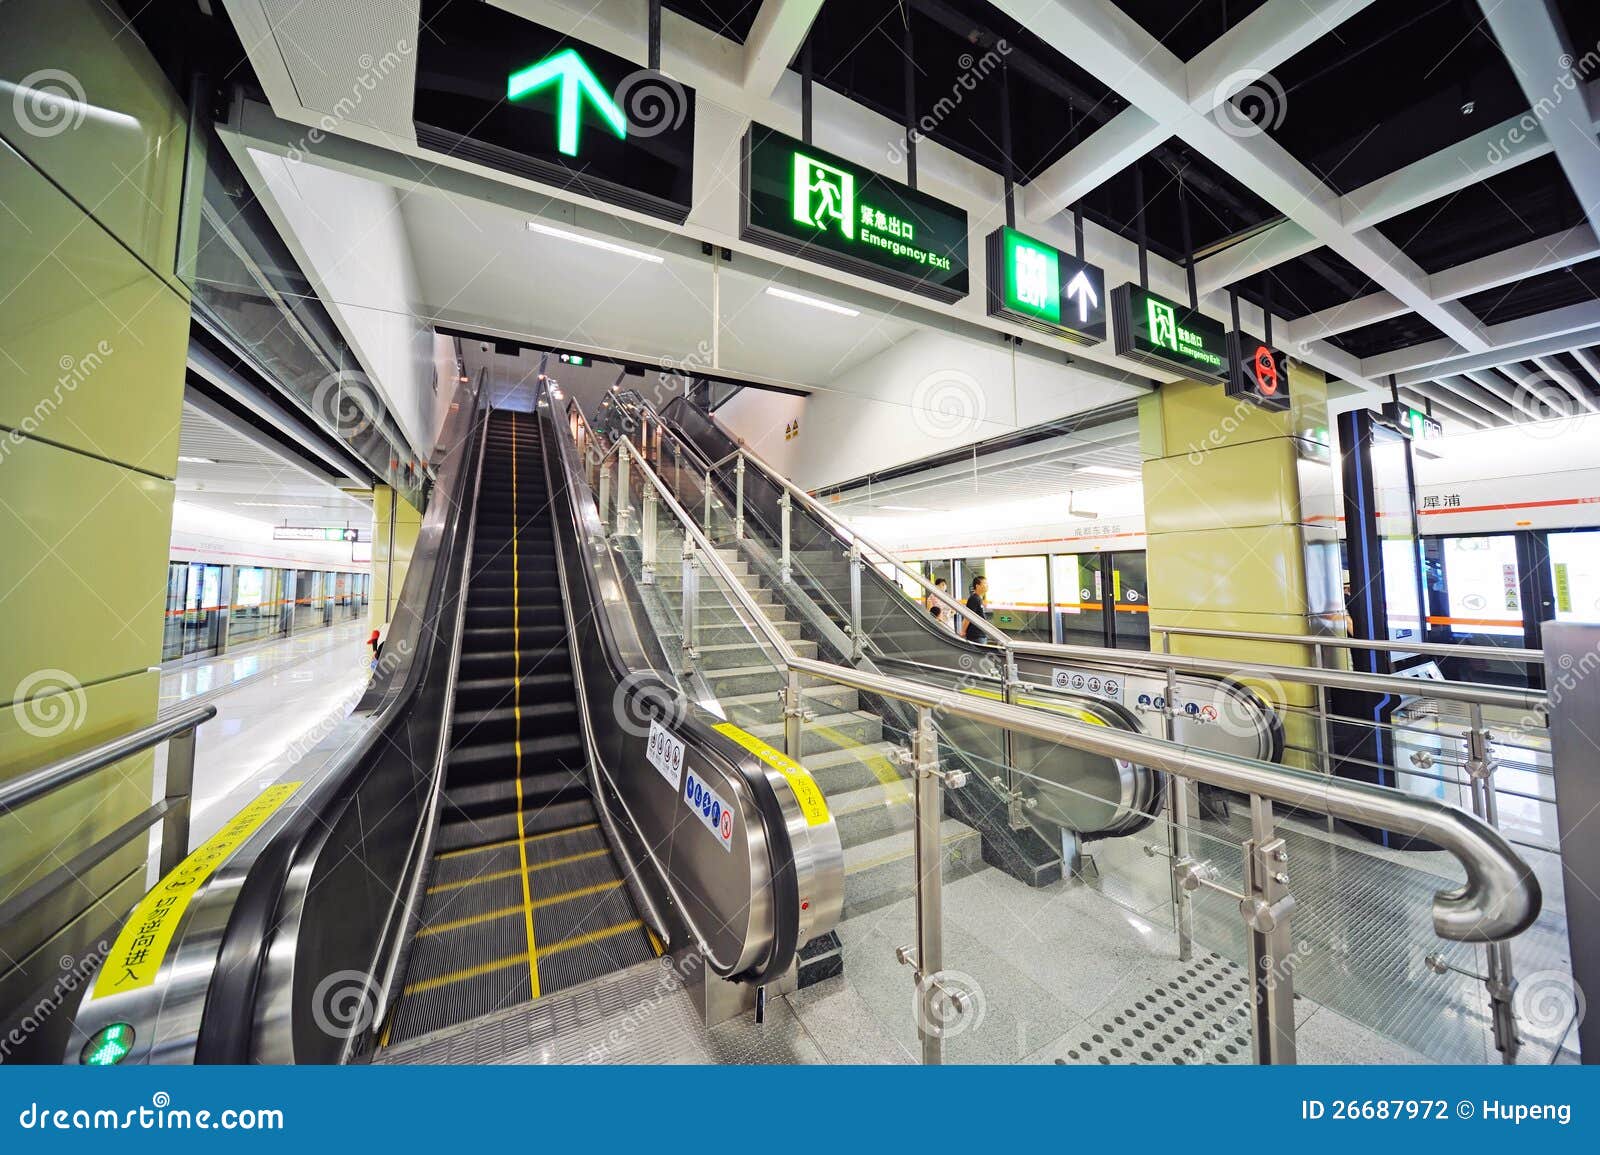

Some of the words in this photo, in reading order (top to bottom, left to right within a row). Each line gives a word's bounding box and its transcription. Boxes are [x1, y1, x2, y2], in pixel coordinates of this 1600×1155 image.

[861, 204, 913, 241] 紧急出口
[861, 228, 927, 264] Emergency
[928, 252, 950, 271] Exit
[1180, 343, 1210, 364] Emergency
[1423, 494, 1461, 509] 犀浦
[114, 896, 178, 986] 切勿逆向进入
